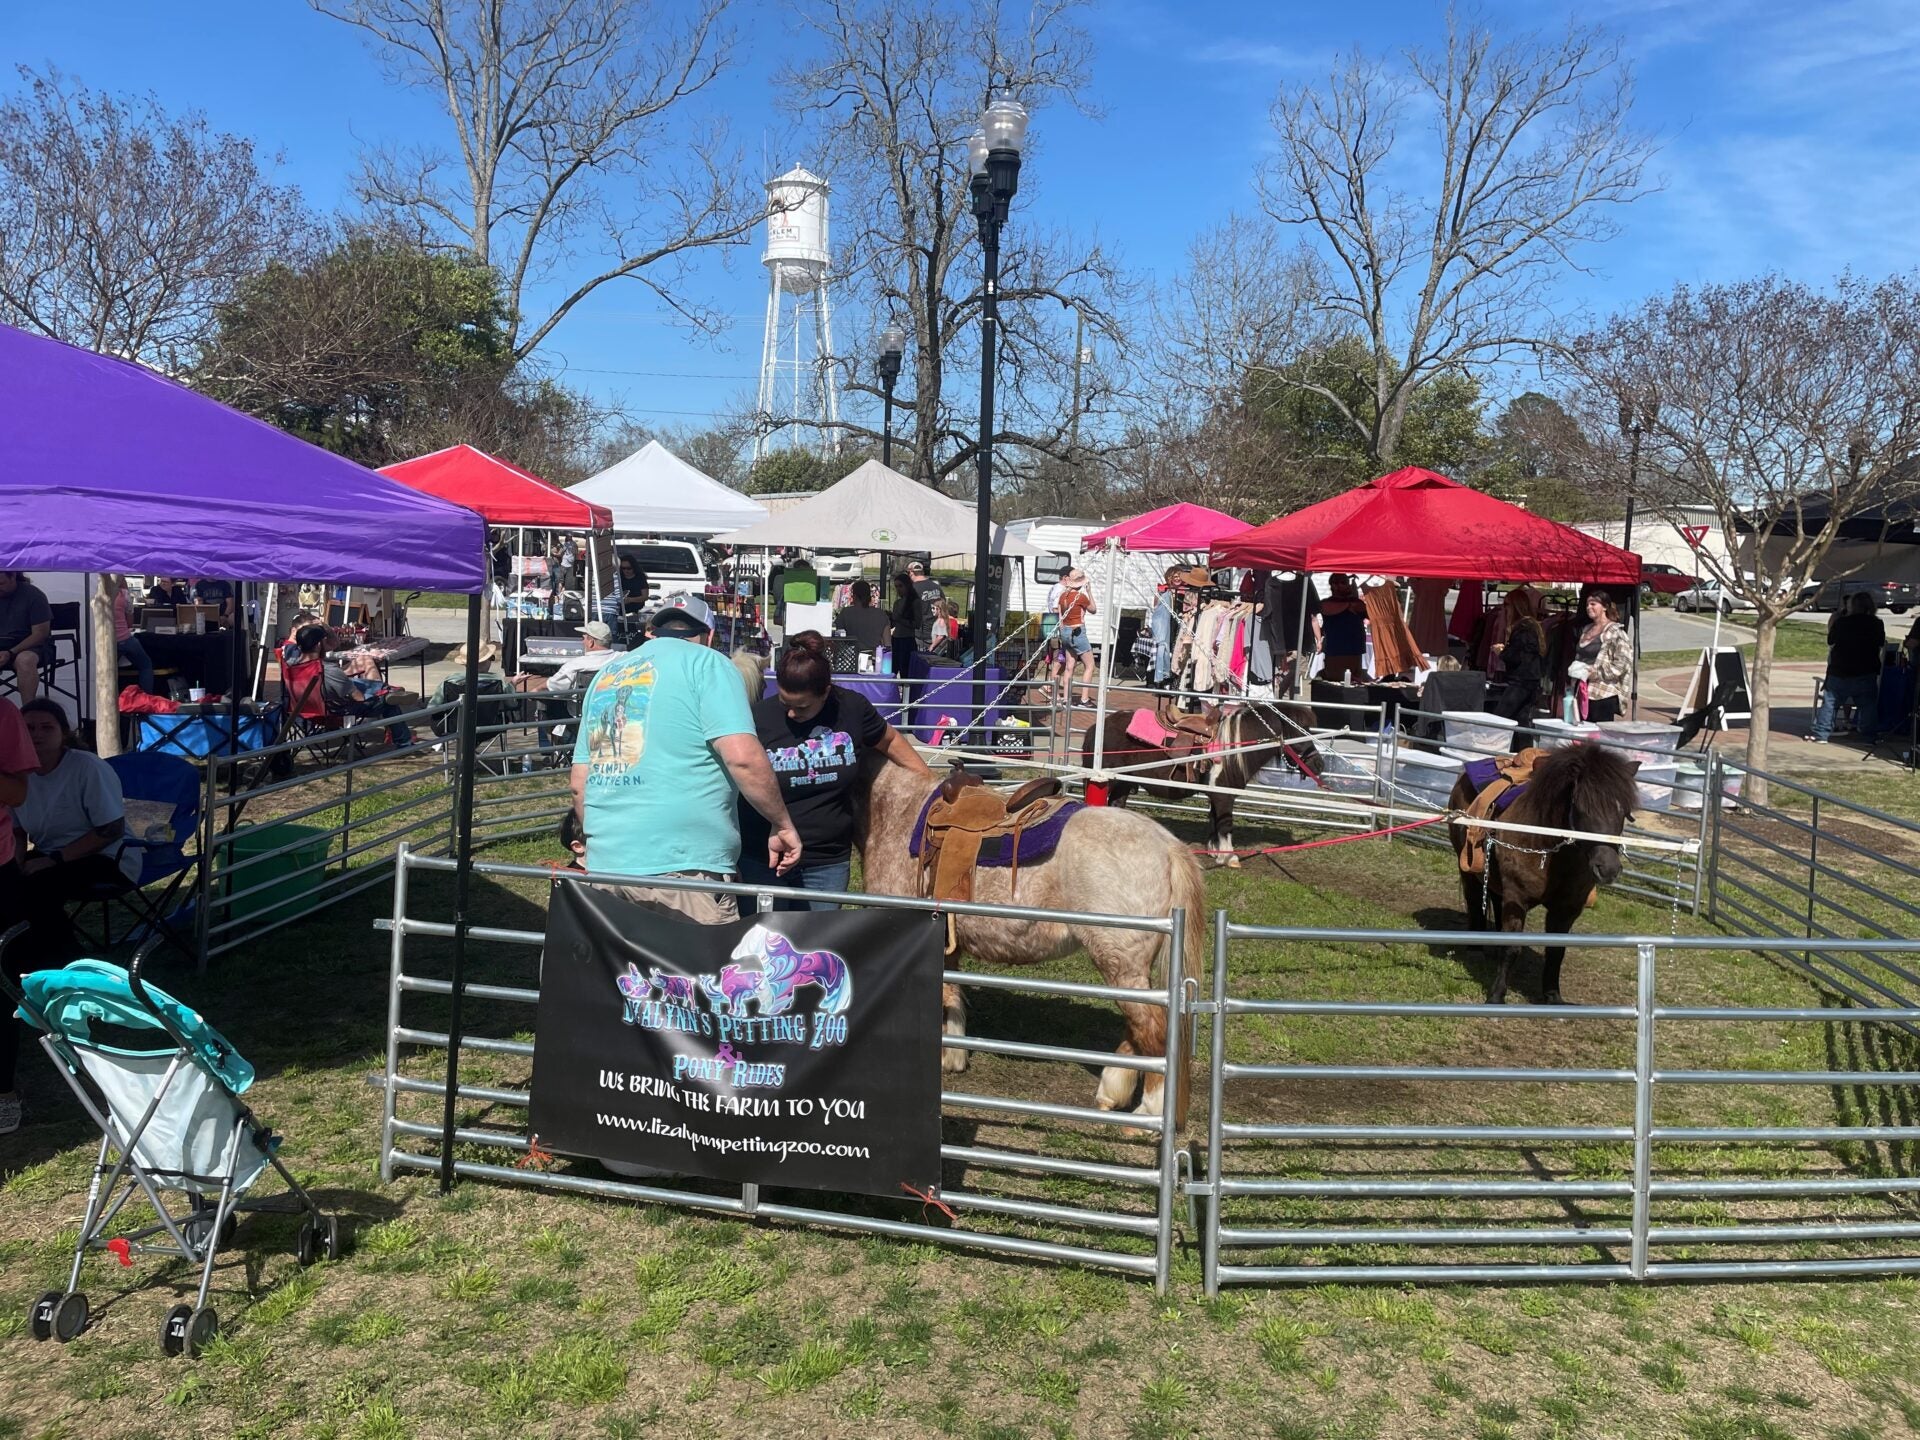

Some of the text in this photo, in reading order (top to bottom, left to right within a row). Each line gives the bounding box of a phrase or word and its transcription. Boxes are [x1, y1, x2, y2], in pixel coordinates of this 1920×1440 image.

[586, 775, 642, 786] OUTHERN
[593, 762, 630, 774] SIMPLY
[622, 998, 848, 1049] LZALYNN'S PETTING ZOO
[673, 1054, 786, 1088] PONY RIDES
[714, 1042, 743, 1069] &
[599, 1069, 865, 1125] WE BRING THE FARM TO YOU
[596, 1113, 870, 1163] www.lizalynnspettingzoo.com
